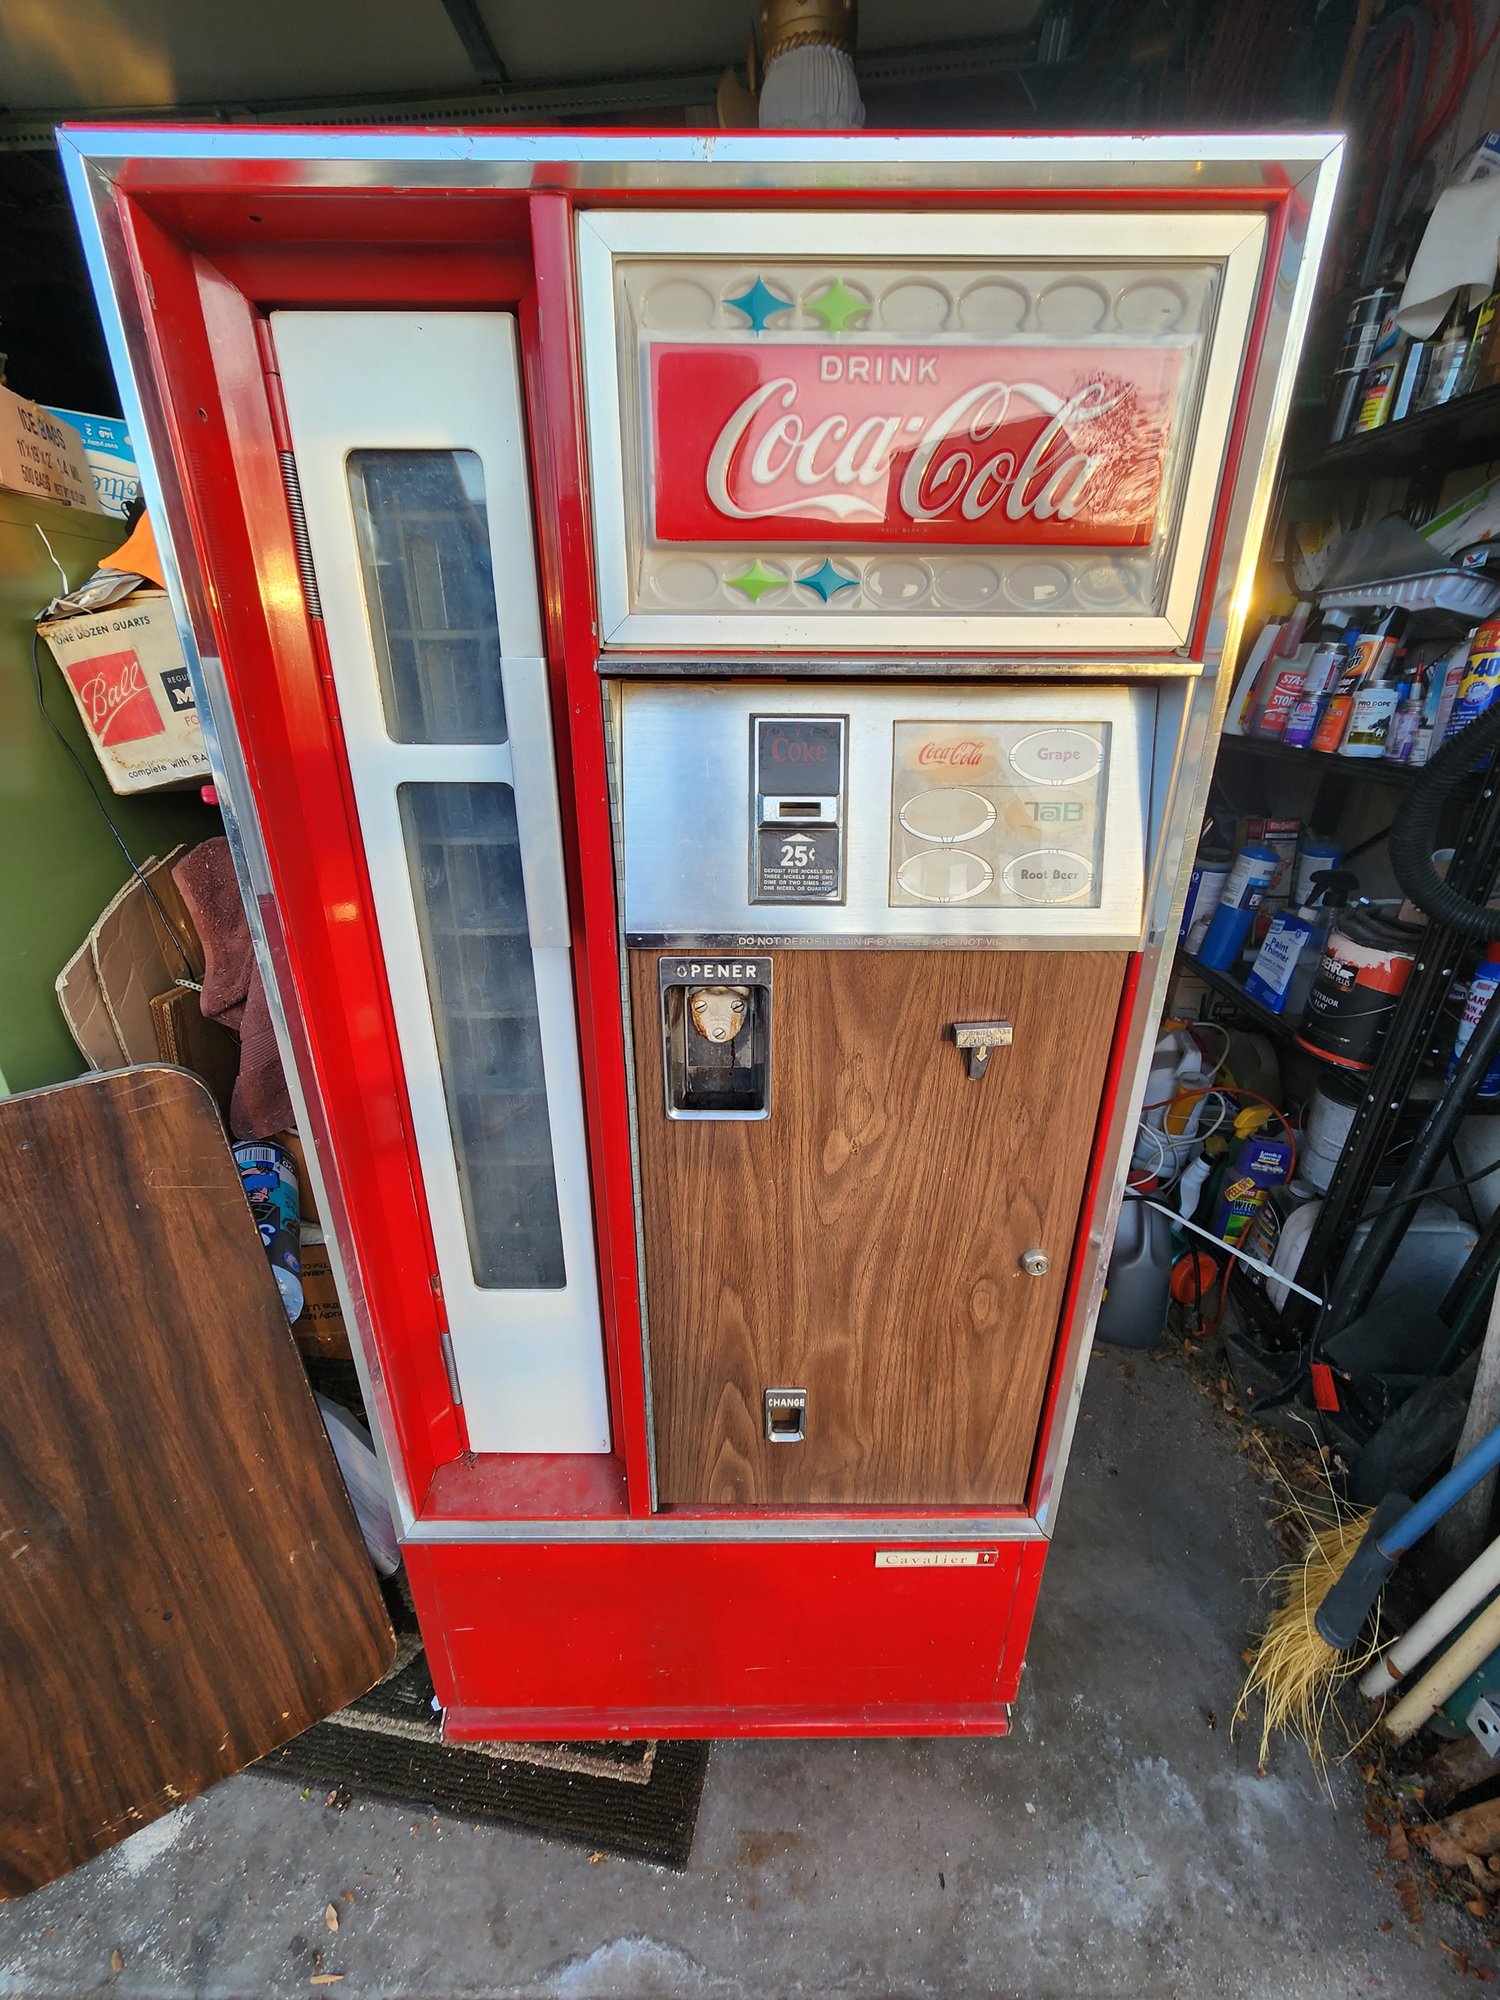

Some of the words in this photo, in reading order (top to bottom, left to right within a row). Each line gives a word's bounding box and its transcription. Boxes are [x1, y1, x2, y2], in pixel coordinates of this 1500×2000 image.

[819, 354, 942, 385] DRINK
[17, 406, 39, 436] ICE
[706, 376, 1133, 521] Coca-Cola
[56, 632, 75, 646] ONE
[78, 625, 110, 640] DOZEN
[112, 615, 151, 632] QUARTS
[167, 674, 189, 684] REGU
[81, 661, 148, 724] Ball
[1372, 700, 1392, 708] DOPE
[184, 715, 200, 727] FO
[771, 736, 828, 764] Coke
[918, 741, 986, 766] Coca-Cola
[1037, 748, 1081, 763] Grape
[128, 764, 168, 779] complete
[171, 757, 190, 770] with
[192, 753, 209, 766] BA
[780, 845, 816, 867] 25¢
[1020, 869, 1048, 880] Root
[1052, 869, 1080, 881] Beer
[738, 937, 755, 946] DO
[757, 937, 782, 946] NOT
[784, 937, 832, 946] DEPOSIT
[836, 937, 862, 946] COIN
[864, 937, 875, 946] IF
[932, 938, 956, 946] ARE
[959, 938, 983, 946] NOT
[1270, 937, 1289, 953] Paint
[1264, 943, 1289, 963] Thinner
[676, 963, 758, 979] OPENER
[1313, 989, 1339, 1008] TERIOR
[1467, 989, 1490, 1006] CAR
[320, 1311, 342, 1321] udly
[768, 1398, 805, 1407] CHANGE
[885, 1554, 968, 1564] Cavalier
